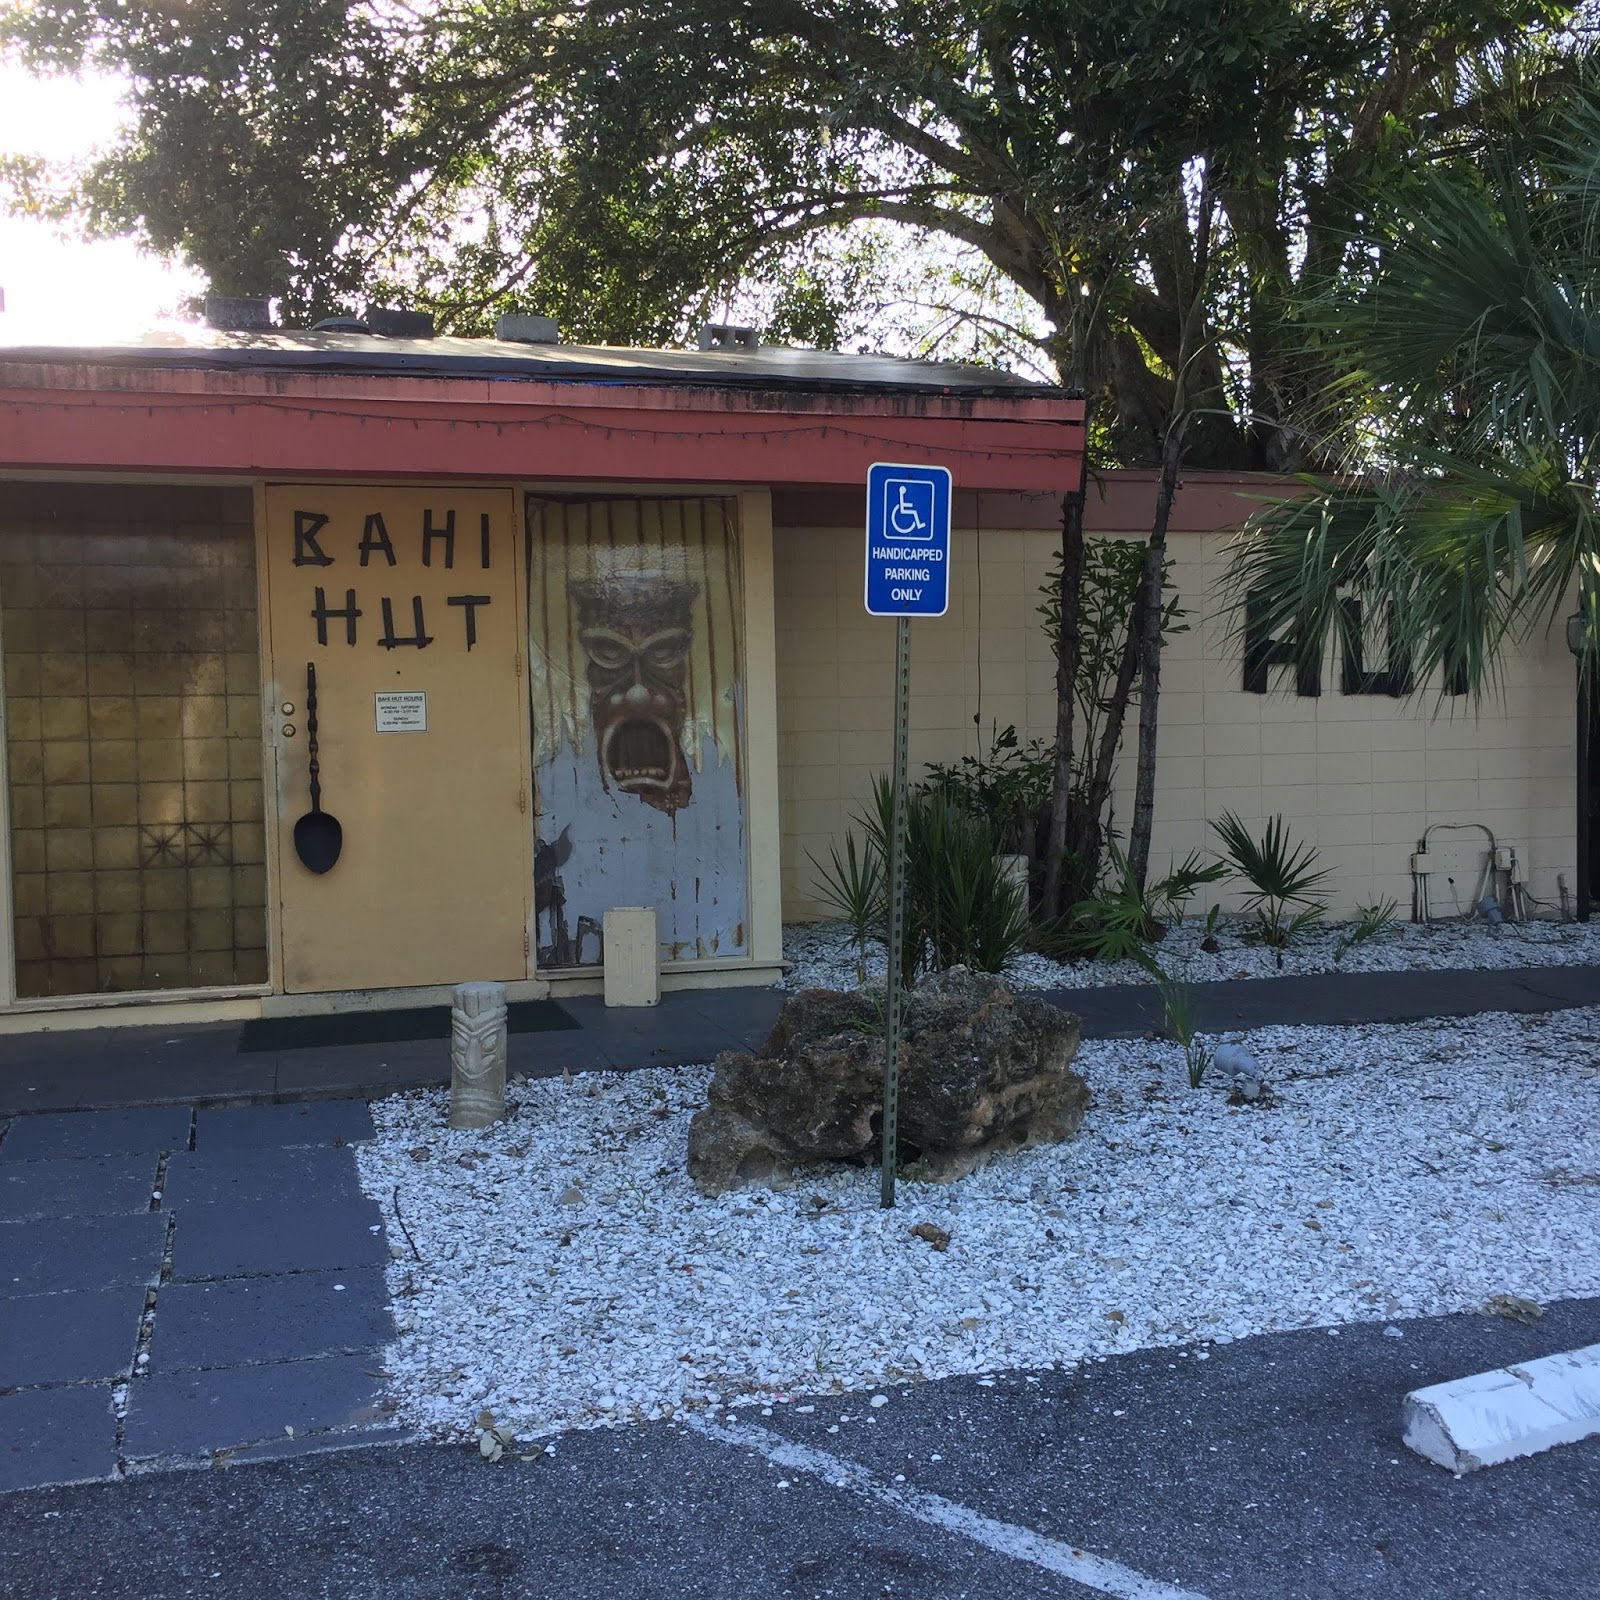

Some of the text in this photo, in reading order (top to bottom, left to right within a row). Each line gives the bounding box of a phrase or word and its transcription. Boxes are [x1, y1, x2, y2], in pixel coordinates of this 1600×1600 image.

[292, 509, 490, 569] BAHI
[873, 547, 943, 561] HANDICAPPED
[885, 568, 930, 581] PARKING
[891, 588, 922, 601] ONLY
[311, 586, 491, 652] HUT
